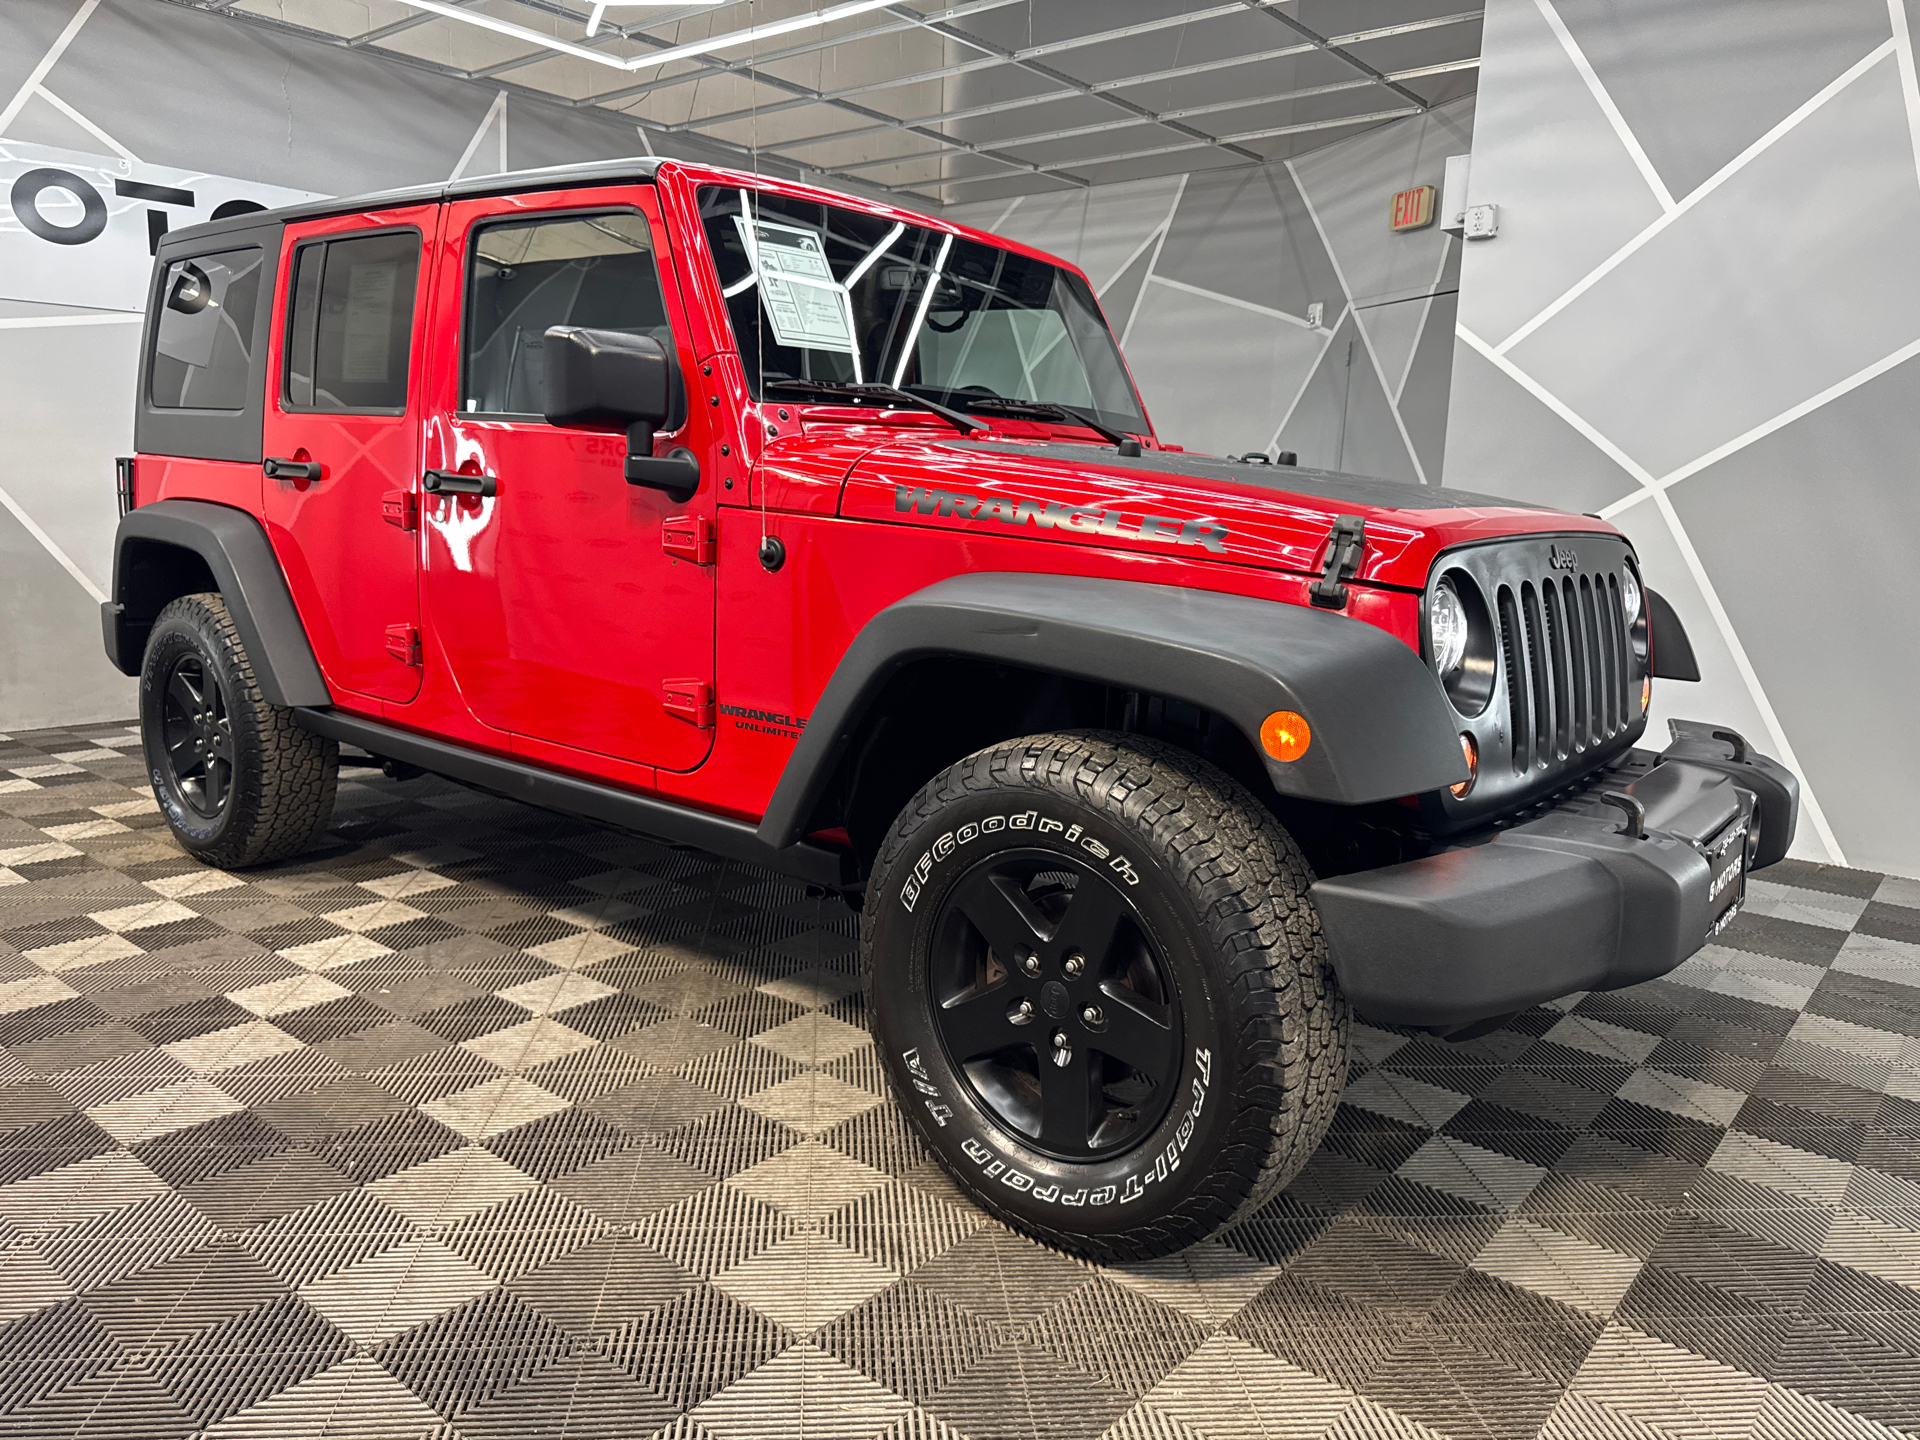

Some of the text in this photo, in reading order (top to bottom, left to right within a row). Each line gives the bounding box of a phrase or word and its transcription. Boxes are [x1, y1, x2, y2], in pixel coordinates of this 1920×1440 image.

[10, 167, 270, 256] OT
[1394, 188, 1424, 227] EXIT
[895, 485, 1229, 554] WRANGLER
[1548, 544, 1578, 573] Jeep
[719, 703, 808, 729] WRANGLE
[735, 721, 802, 740] UNLIMITE
[901, 810, 1139, 913] BFGoodrich
[902, 1046, 954, 1128] T/A
